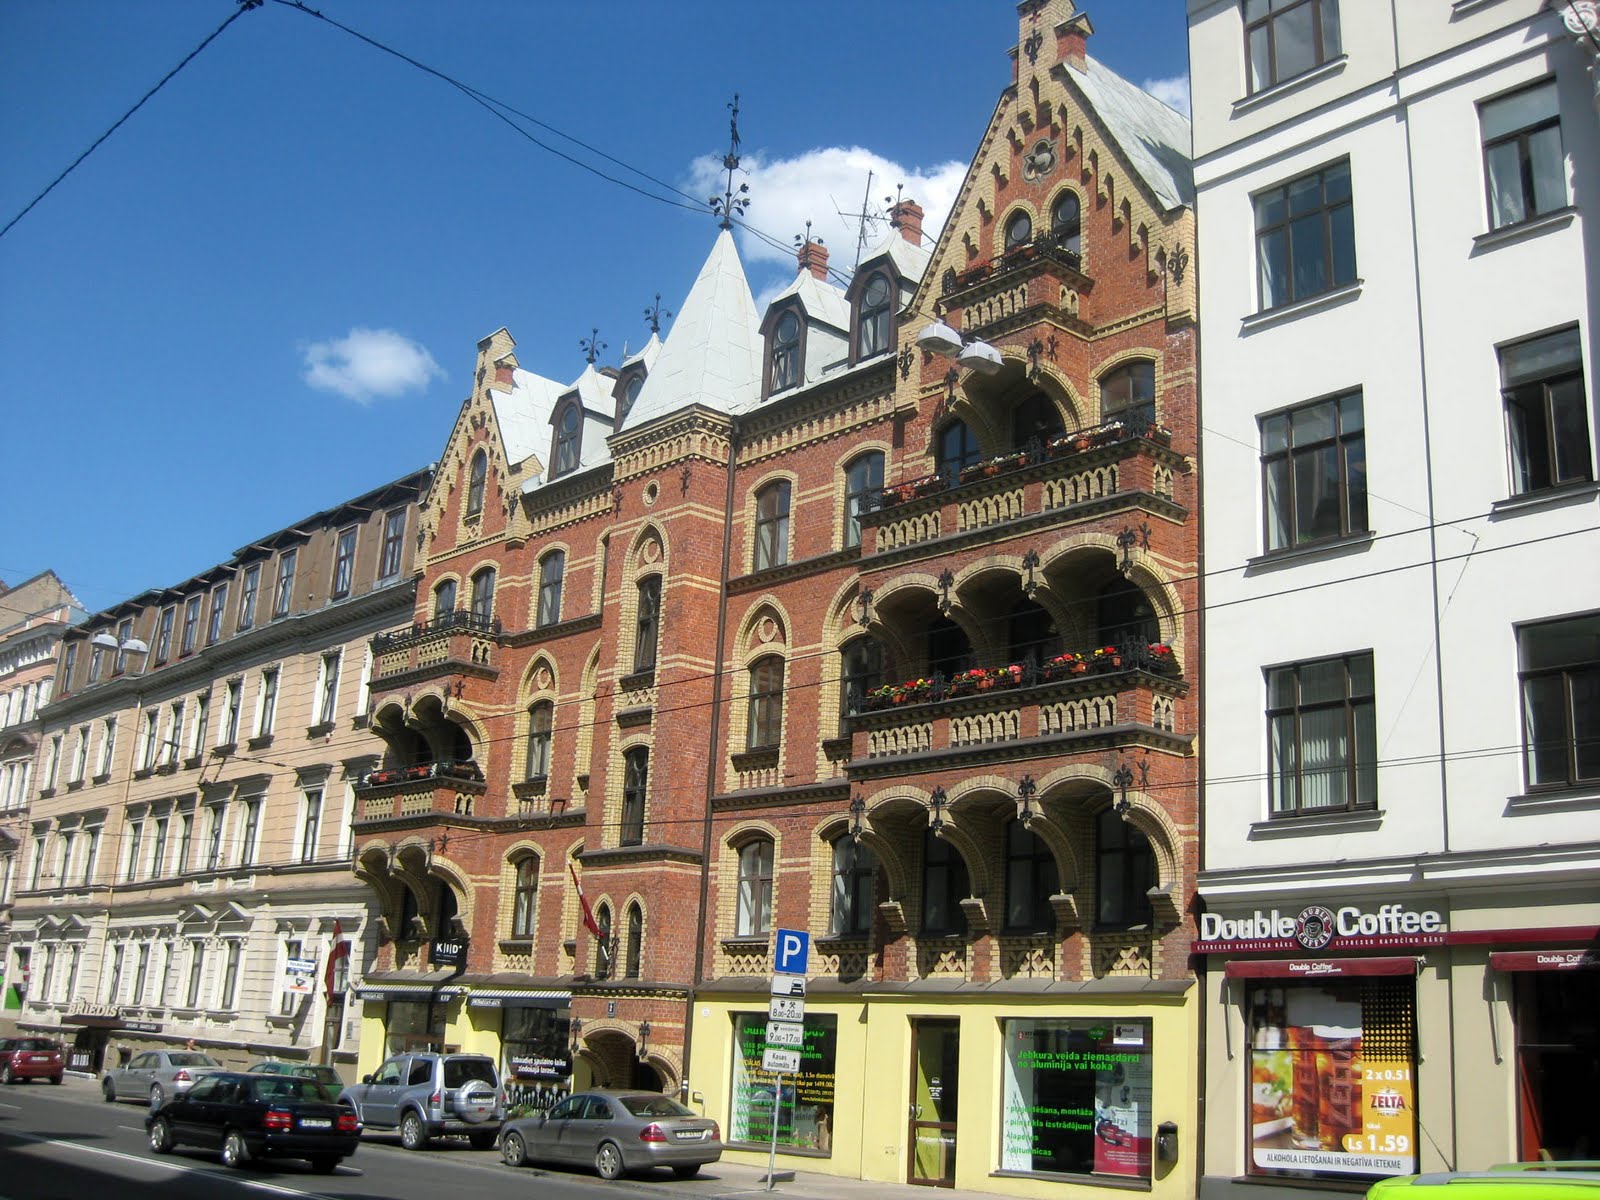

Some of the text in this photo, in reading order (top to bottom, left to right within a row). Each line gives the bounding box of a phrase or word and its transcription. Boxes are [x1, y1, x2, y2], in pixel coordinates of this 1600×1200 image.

[1201, 904, 1441, 940] Double Coffee
[1298, 908, 1329, 923] DOUBLE
[1298, 930, 1330, 947] COFFEE
[782, 935, 801, 967] P
[1537, 955, 1564, 963] Double
[1289, 962, 1332, 971] Double Coffee
[67, 1002, 118, 1017] BRIEDIS
[772, 1052, 787, 1061] Kases
[1018, 1051, 1053, 1060] Jebkura
[1056, 1052, 1080, 1060] veida
[1074, 1061, 1088, 1070] vai
[1090, 1061, 1113, 1071] koka
[1366, 1069, 1373, 1080] 2
[1376, 1072, 1382, 1080] x
[1385, 1069, 1402, 1080] 0.5
[1370, 1095, 1406, 1109] ZELTA
[1061, 1106, 1093, 1116] montāža
[1348, 1134, 1409, 1152] Ls 1.59
[1266, 1154, 1401, 1169] ALKOHOLA LIETOŠANAI IR NEGATĪVA IETEKME
